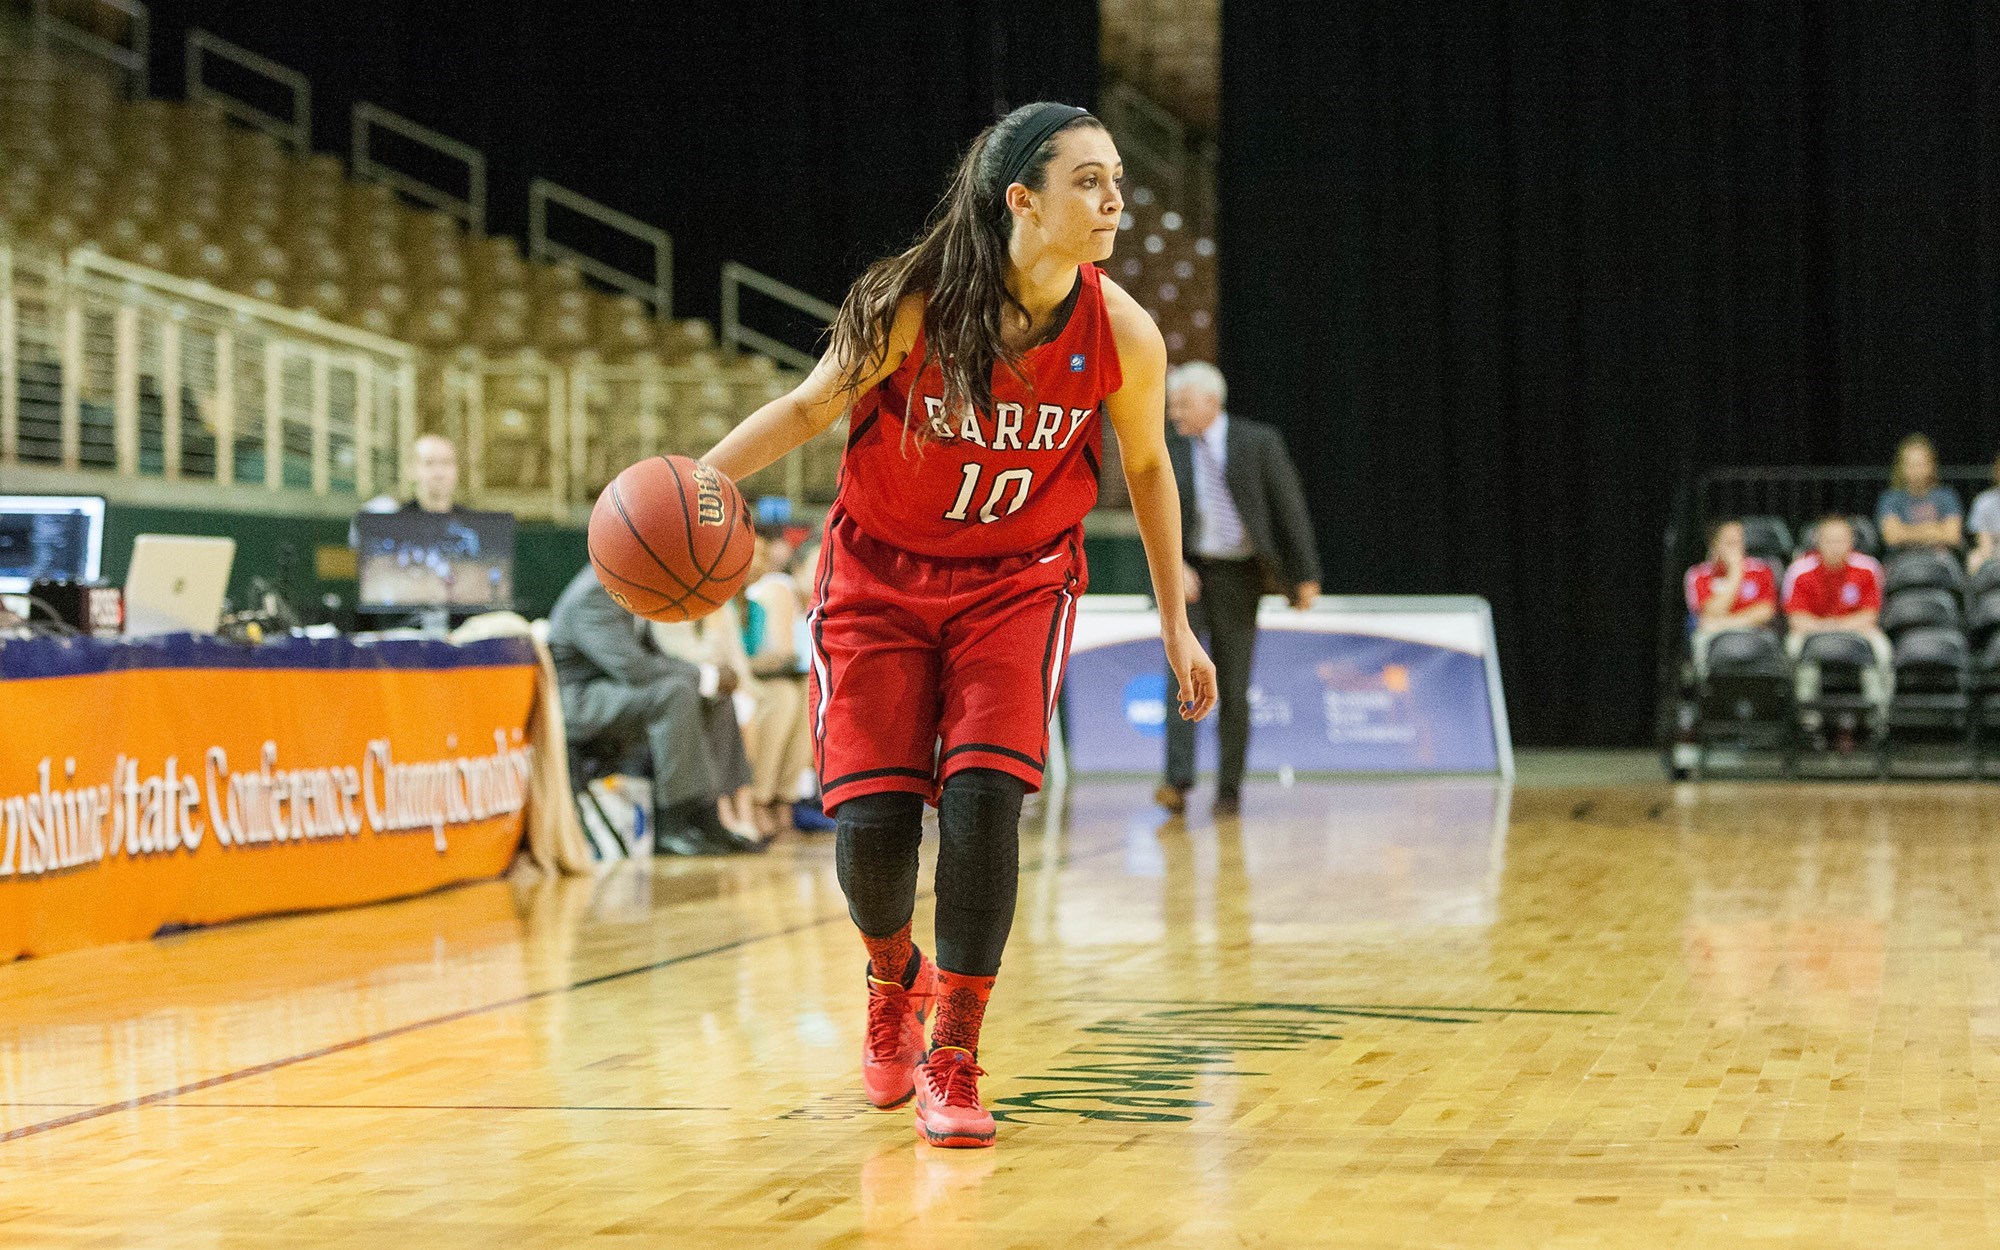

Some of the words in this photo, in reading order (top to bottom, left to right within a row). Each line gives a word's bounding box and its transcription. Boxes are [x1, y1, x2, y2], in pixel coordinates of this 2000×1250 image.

[924, 395, 1092, 450] BARRY
[944, 462, 1033, 524] 10
[0, 757, 111, 875] nshine
[206, 740, 364, 846] Conference
